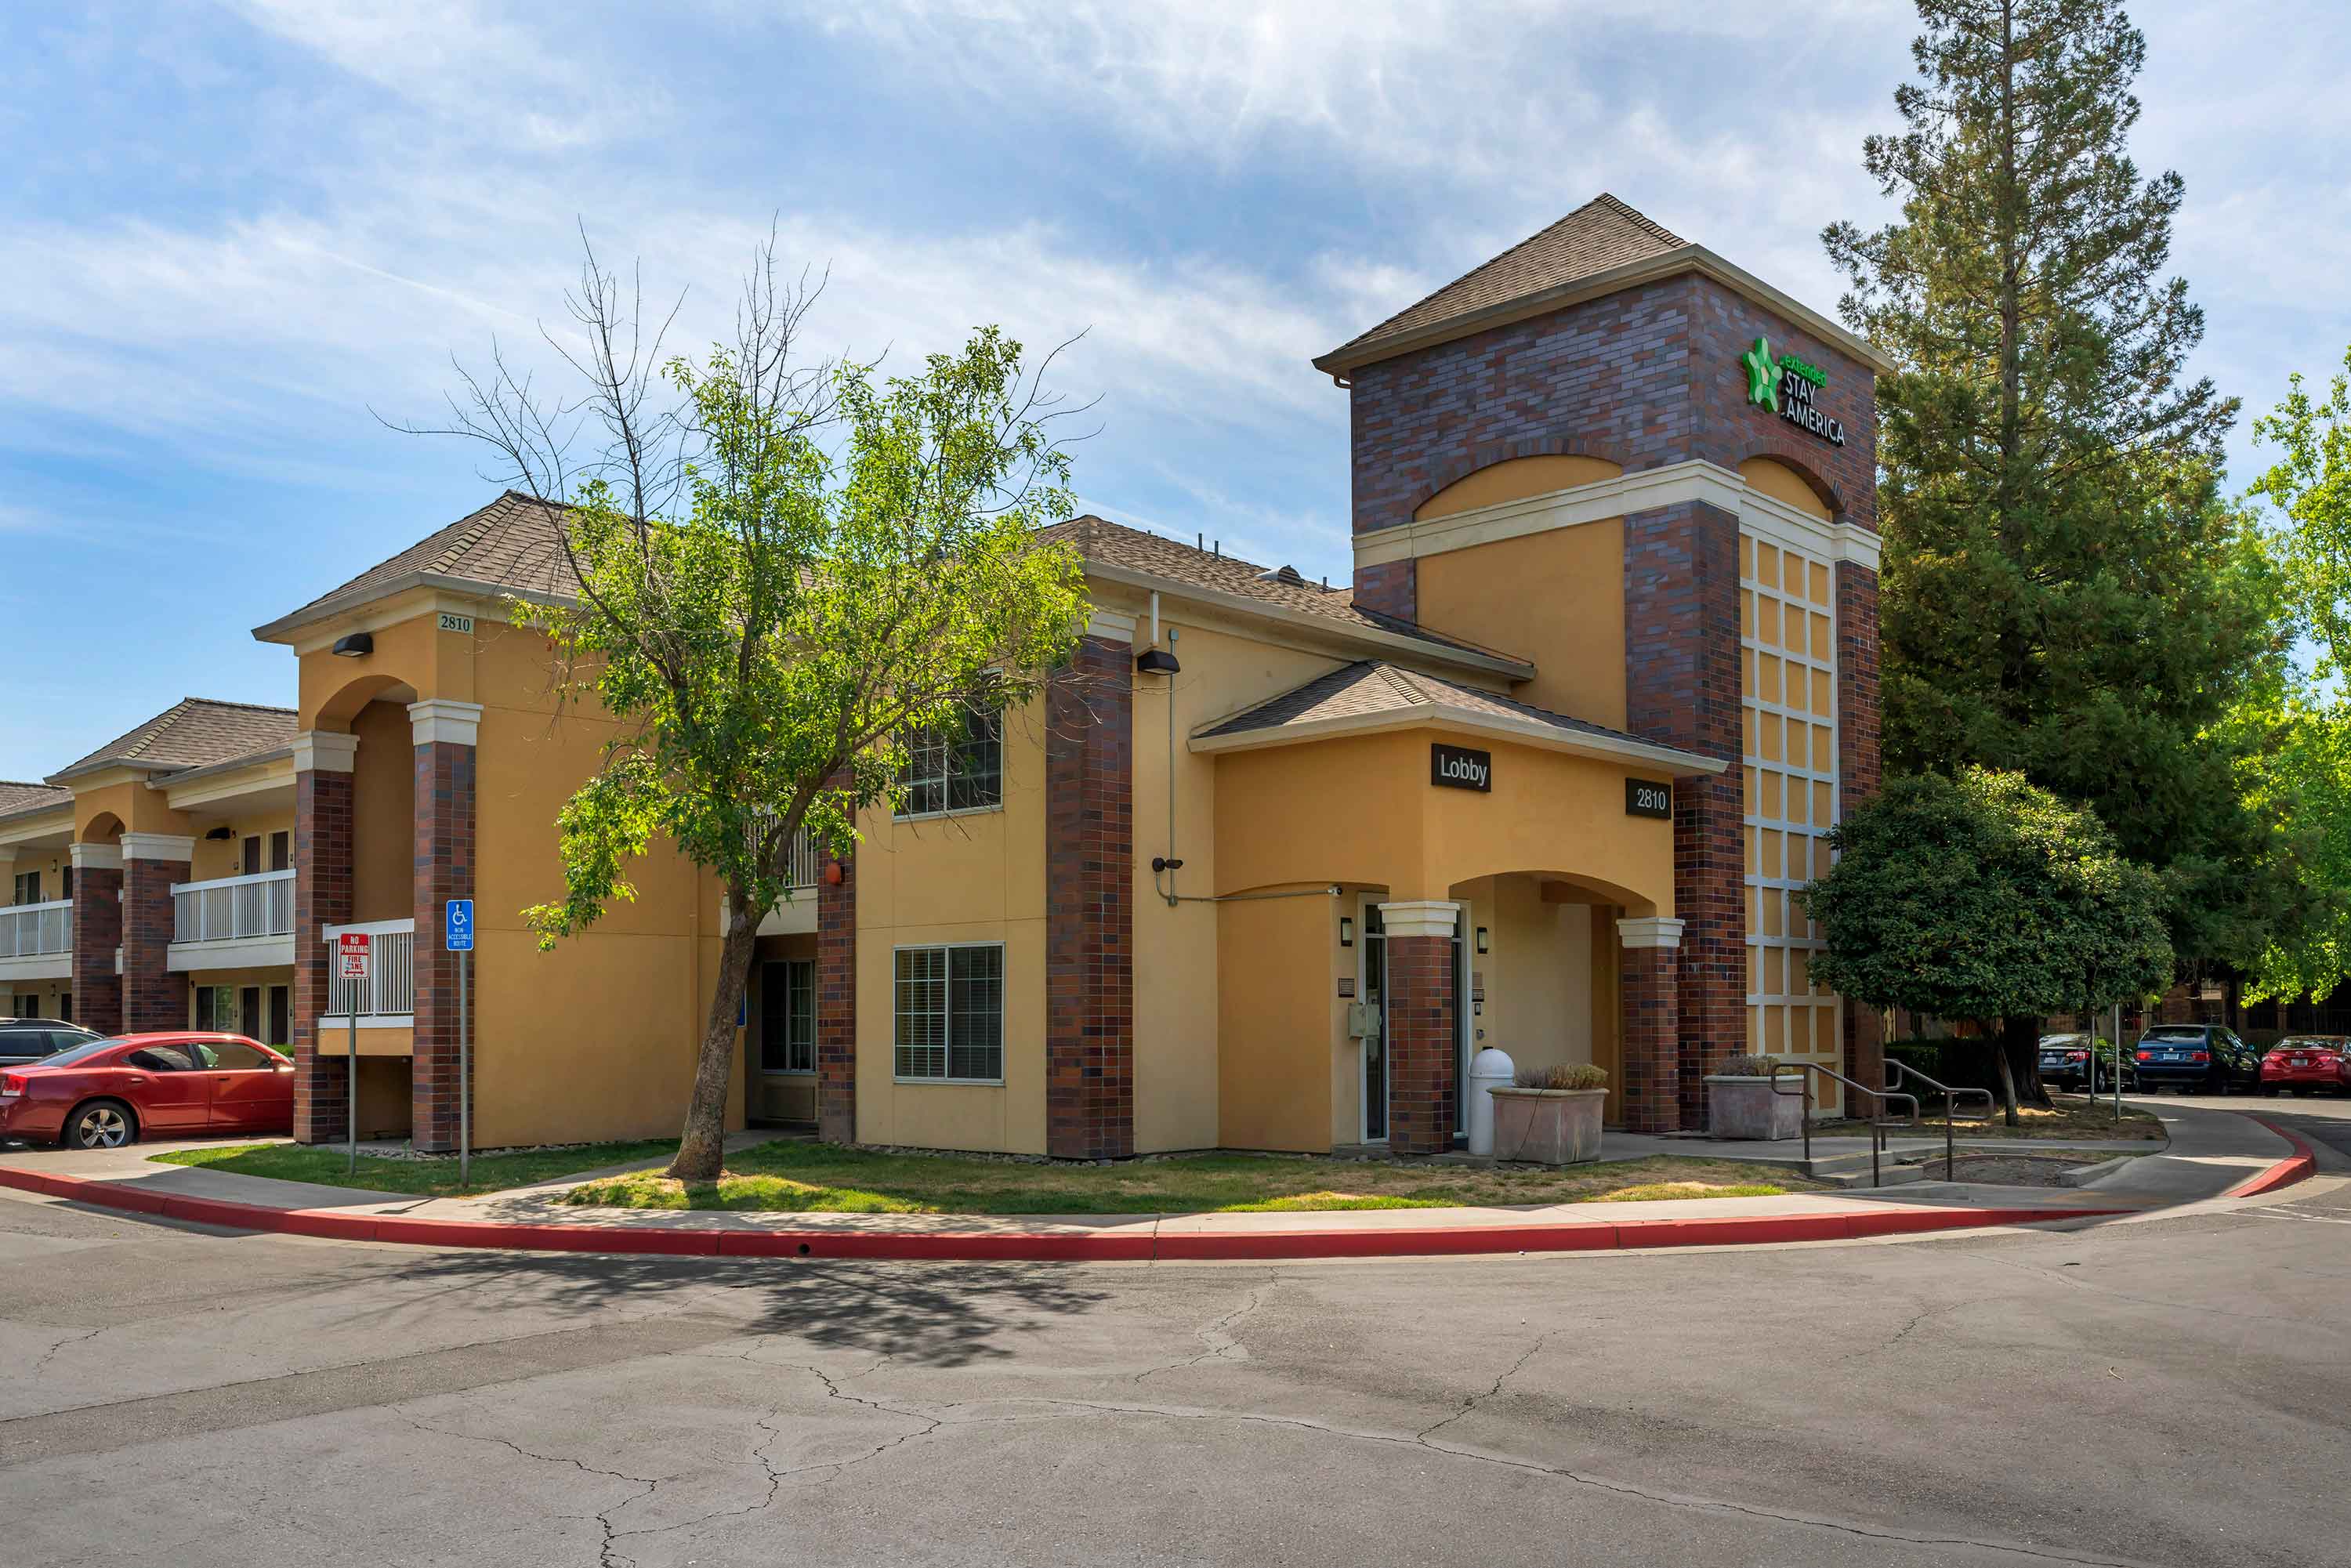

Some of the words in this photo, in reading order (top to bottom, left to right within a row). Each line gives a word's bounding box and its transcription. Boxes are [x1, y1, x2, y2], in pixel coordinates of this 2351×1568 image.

[1785, 356, 1826, 388] extended
[1785, 370, 1816, 406] STAY
[1786, 397, 1846, 446] AMERICA
[441, 615, 470, 632] 2810
[1440, 754, 1487, 786] Lobby
[1637, 788, 1666, 810] 2810
[341, 944, 368, 954] PARKING
[350, 936, 359, 945] NO
